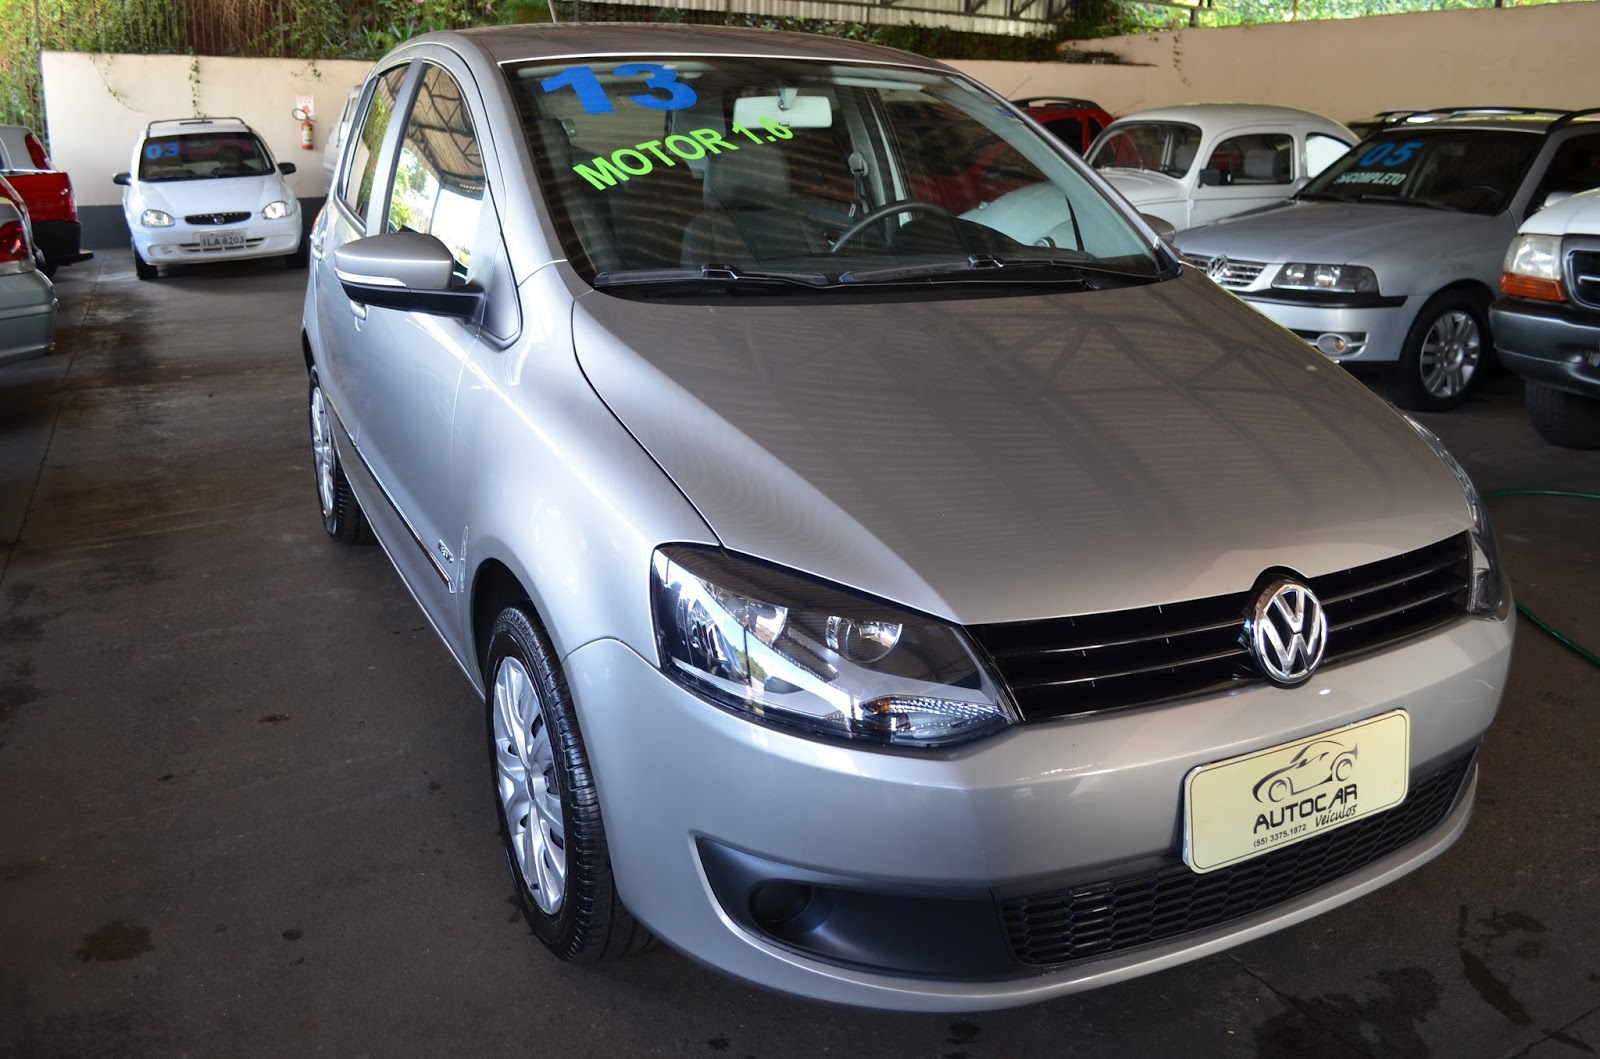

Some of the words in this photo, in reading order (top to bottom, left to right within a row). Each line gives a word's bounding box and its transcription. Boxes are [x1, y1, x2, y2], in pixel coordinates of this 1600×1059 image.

[541, 63, 698, 114] 13
[145, 141, 179, 159] 03
[572, 128, 740, 191] MOTOR
[1358, 140, 1425, 167] 05
[1253, 783, 1358, 834] AUTOCAR
[1253, 837, 1269, 848] (55)
[1269, 823, 1308, 843] 3375.1872
